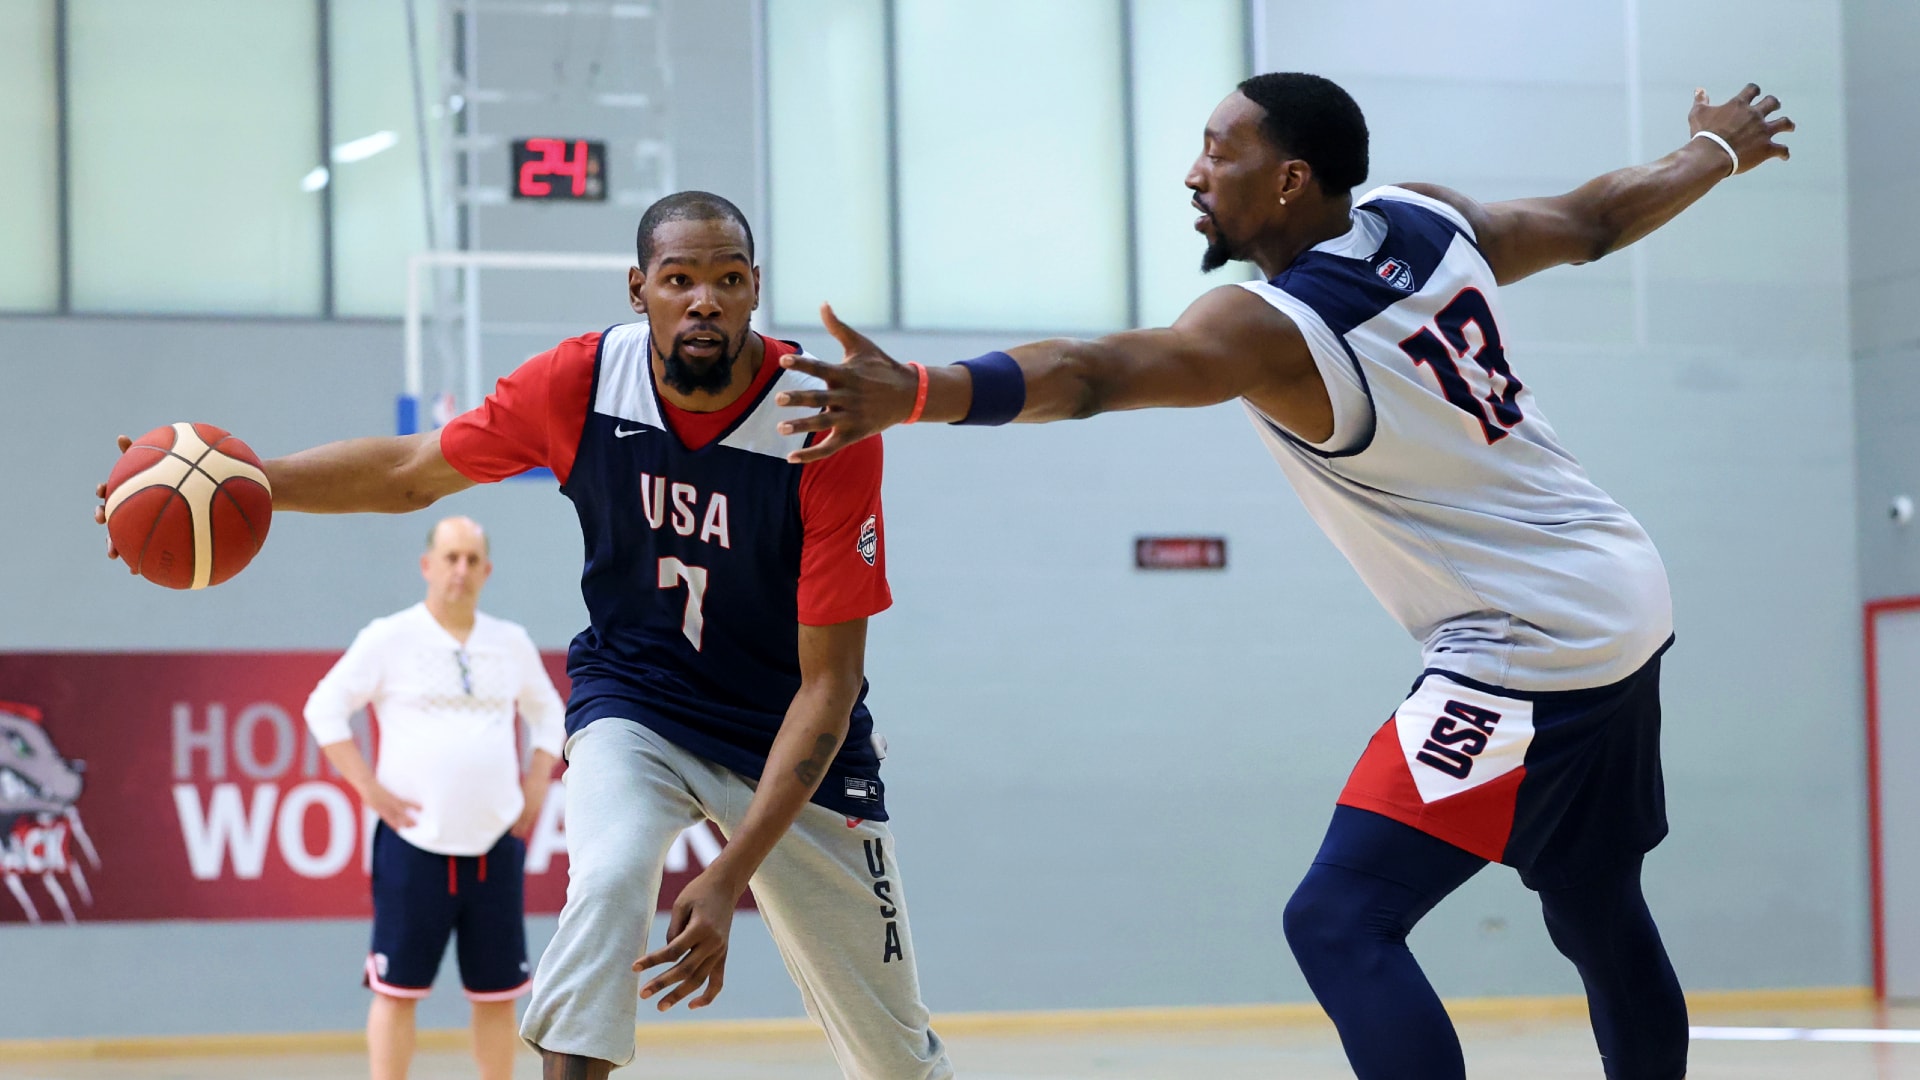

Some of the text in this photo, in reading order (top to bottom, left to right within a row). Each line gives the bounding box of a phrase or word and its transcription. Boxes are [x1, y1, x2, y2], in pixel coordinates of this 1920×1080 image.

[519, 138, 589, 197] 24
[1398, 286, 1524, 445] 13
[639, 471, 731, 550] USA
[657, 555, 709, 653] 7
[1415, 699, 1502, 780] USA
[863, 837, 904, 964] USA
